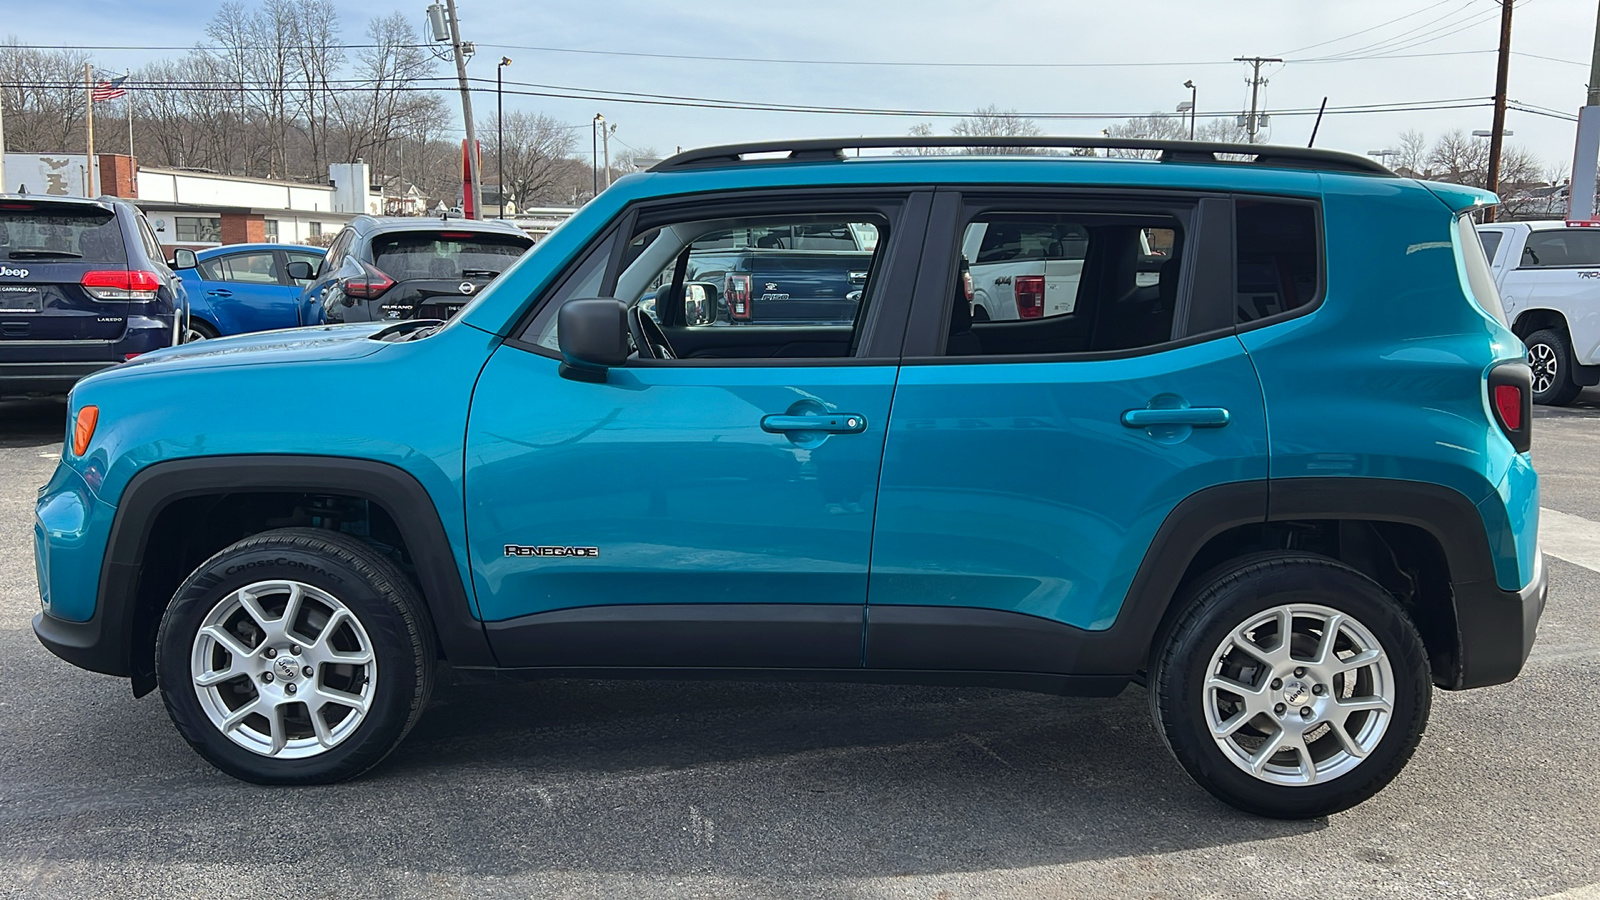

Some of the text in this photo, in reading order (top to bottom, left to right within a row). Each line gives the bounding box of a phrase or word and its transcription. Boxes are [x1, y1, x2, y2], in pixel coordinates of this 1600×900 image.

[0, 266, 29, 279] Jeep
[504, 544, 599, 558] RENEGADE
[278, 661, 294, 678] Jeep
[1289, 685, 1305, 703] Jeep
